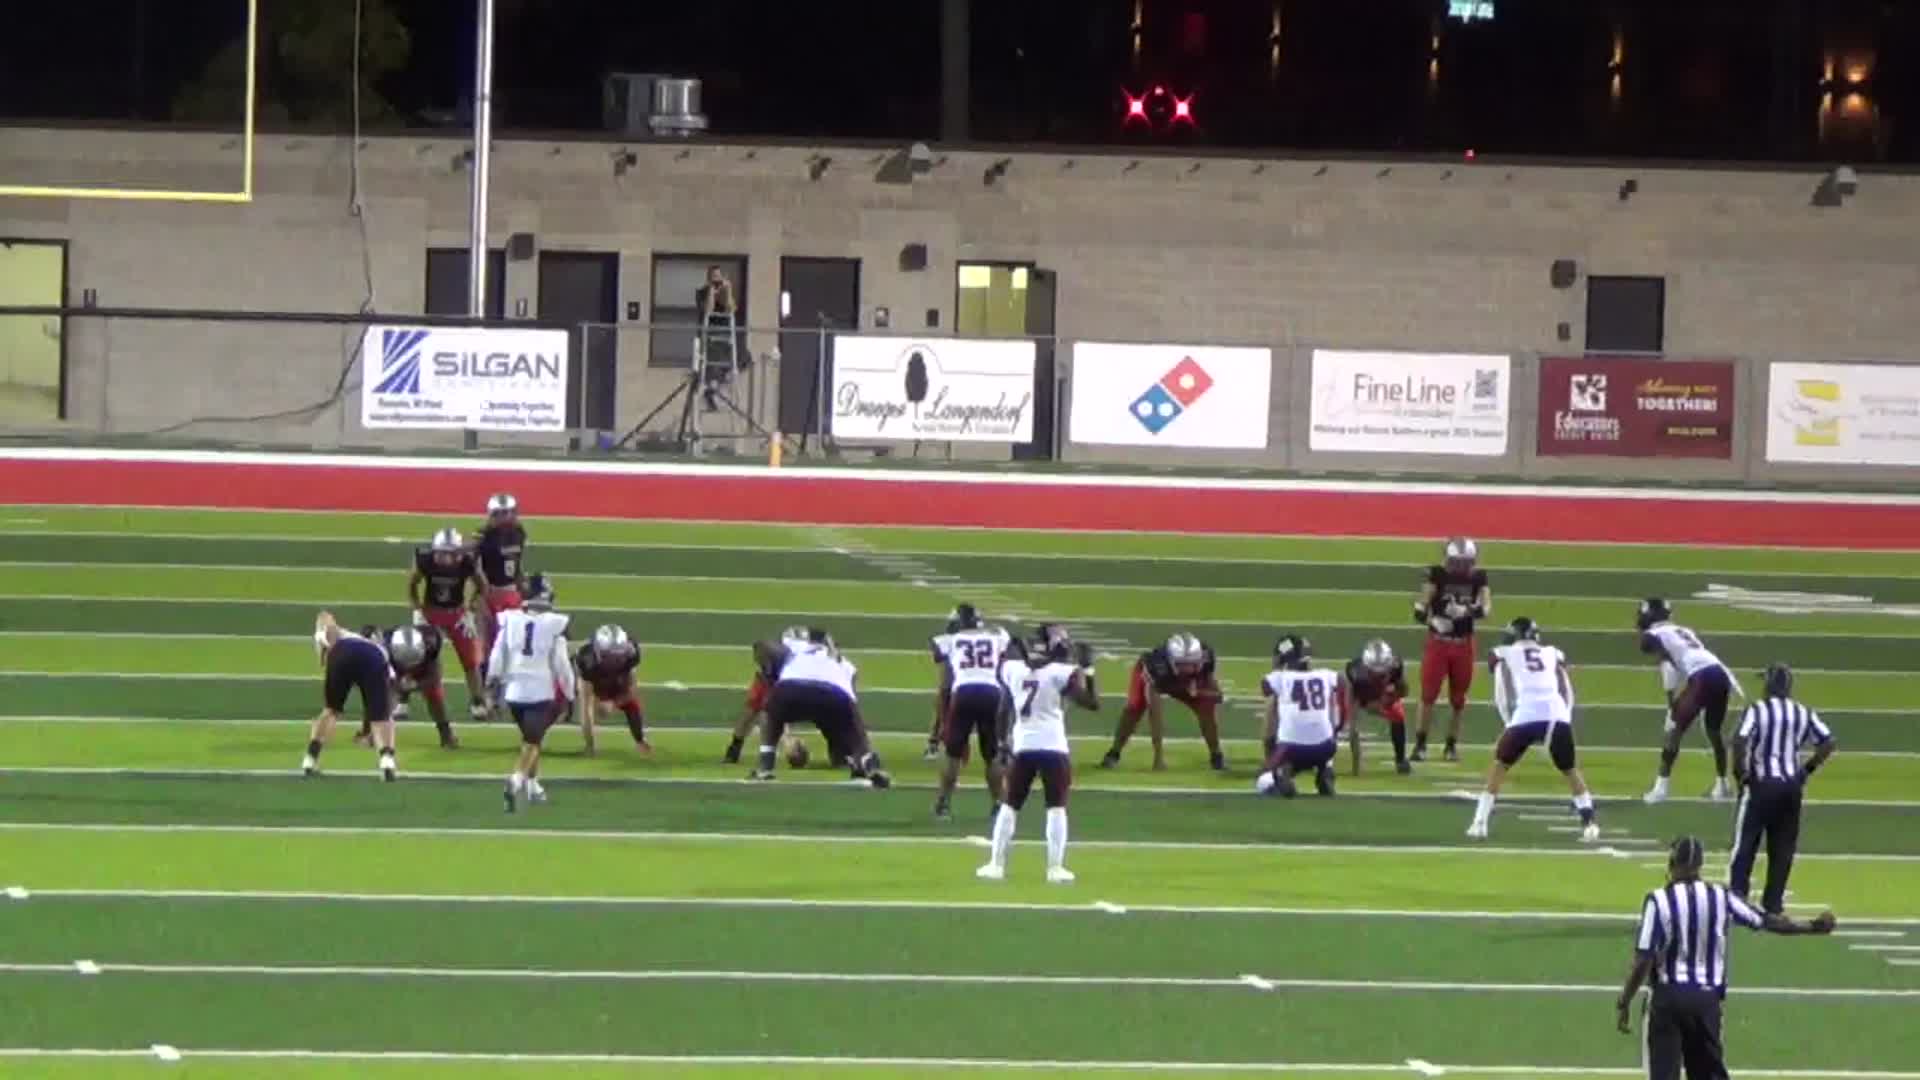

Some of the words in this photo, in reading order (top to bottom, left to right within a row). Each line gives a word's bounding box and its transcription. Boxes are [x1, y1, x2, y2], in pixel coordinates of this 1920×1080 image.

[433, 352, 559, 379] SILGAN
[521, 621, 535, 657] 1
[955, 639, 995, 669] 32
[1523, 647, 1545, 672] 5
[1021, 679, 1039, 718] 7
[1290, 678, 1326, 711] 48
